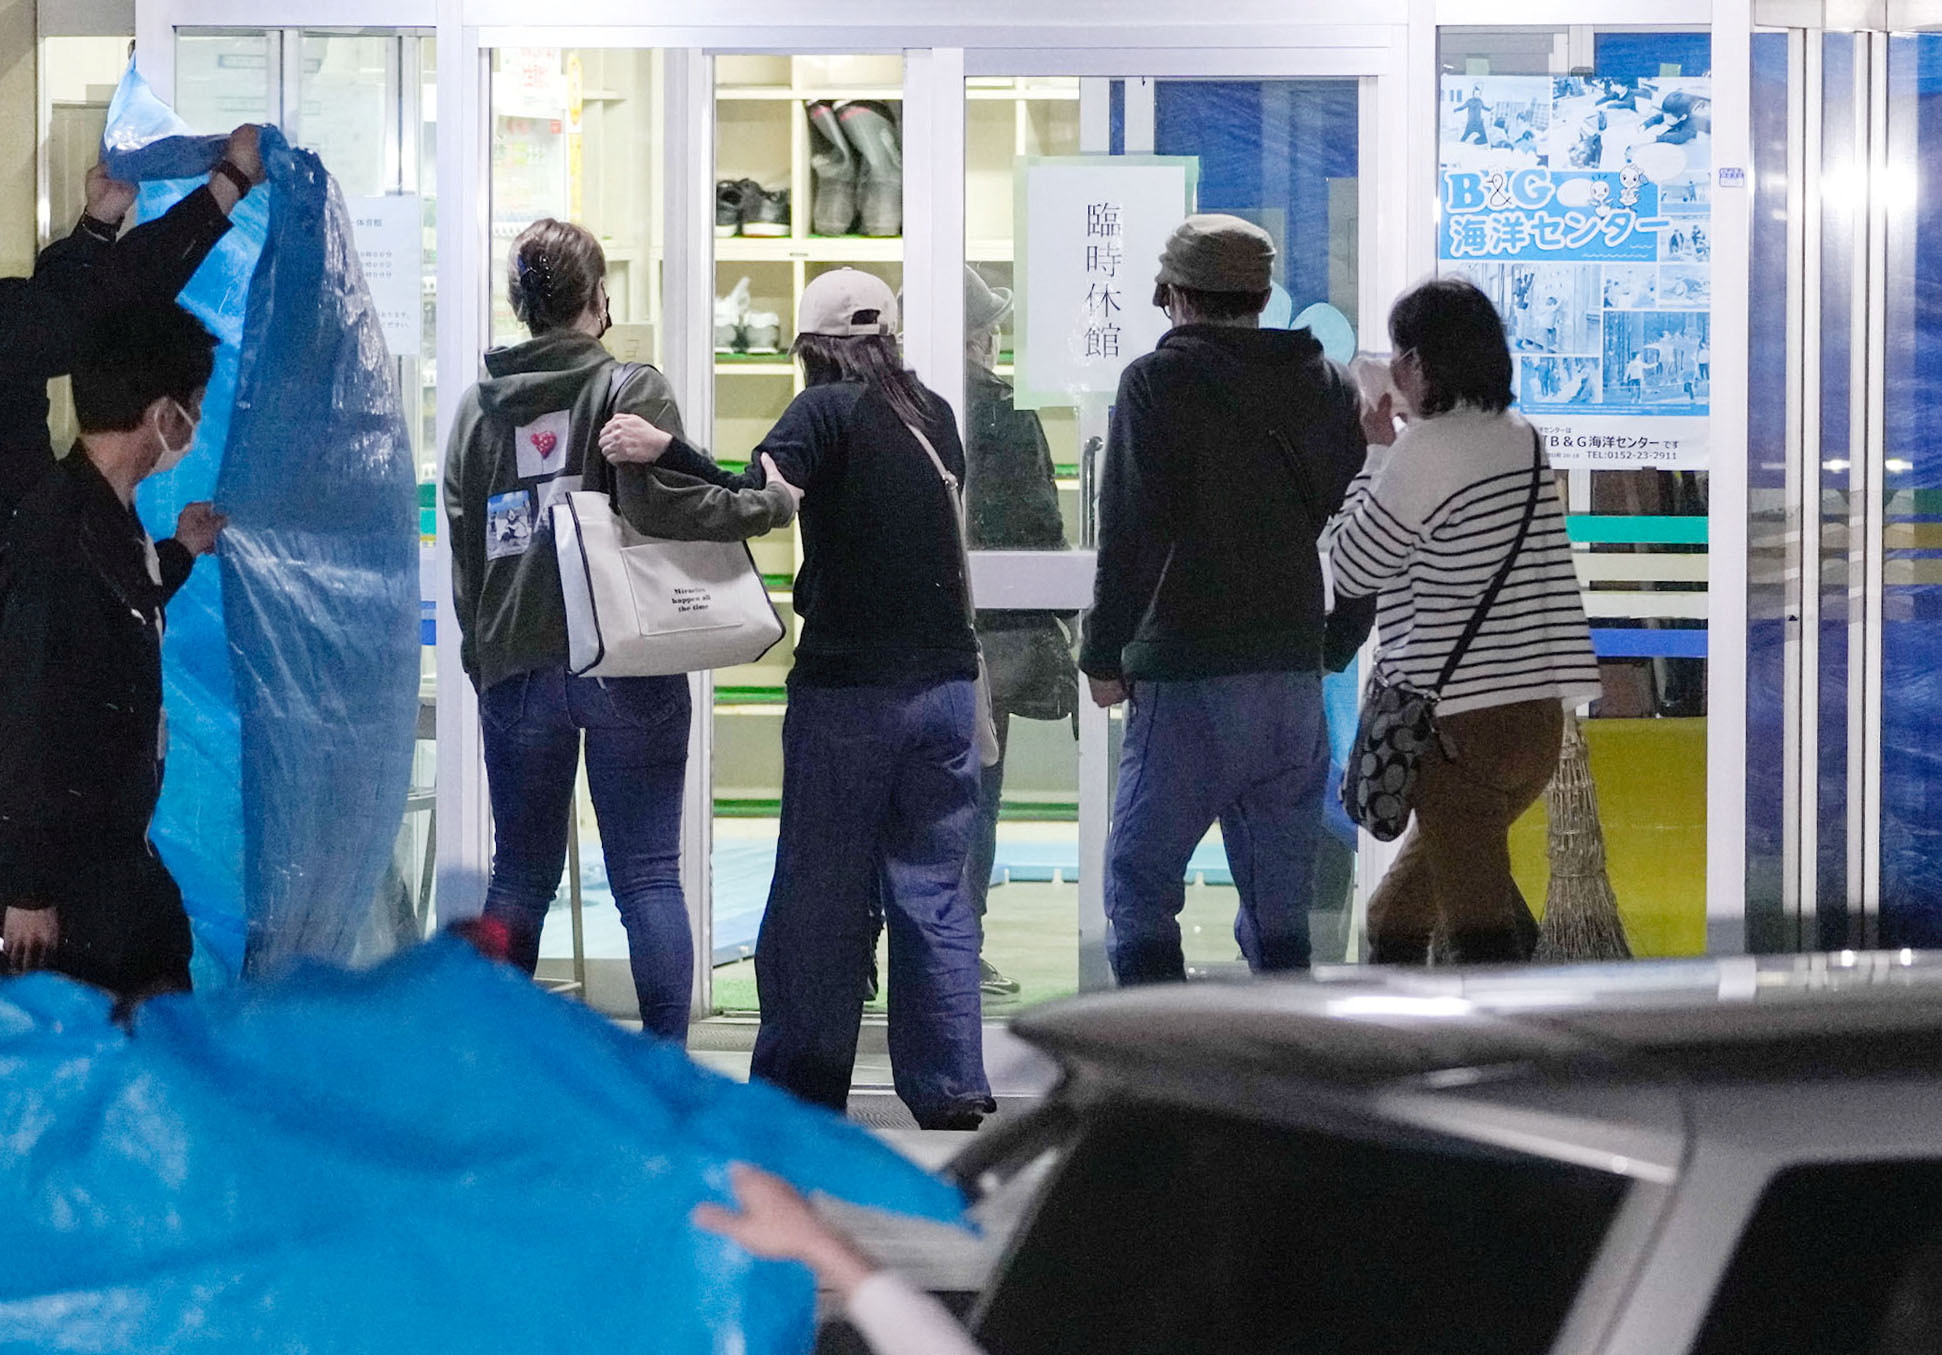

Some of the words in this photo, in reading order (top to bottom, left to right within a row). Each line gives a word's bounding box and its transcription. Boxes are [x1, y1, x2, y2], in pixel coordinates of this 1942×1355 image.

[1446, 169, 1556, 213] B&G
[1449, 212, 1673, 257] 海洋センター
[1085, 202, 1122, 359] 臨時休館
[1587, 450, 1677, 460] TEL:0152-23-2911
